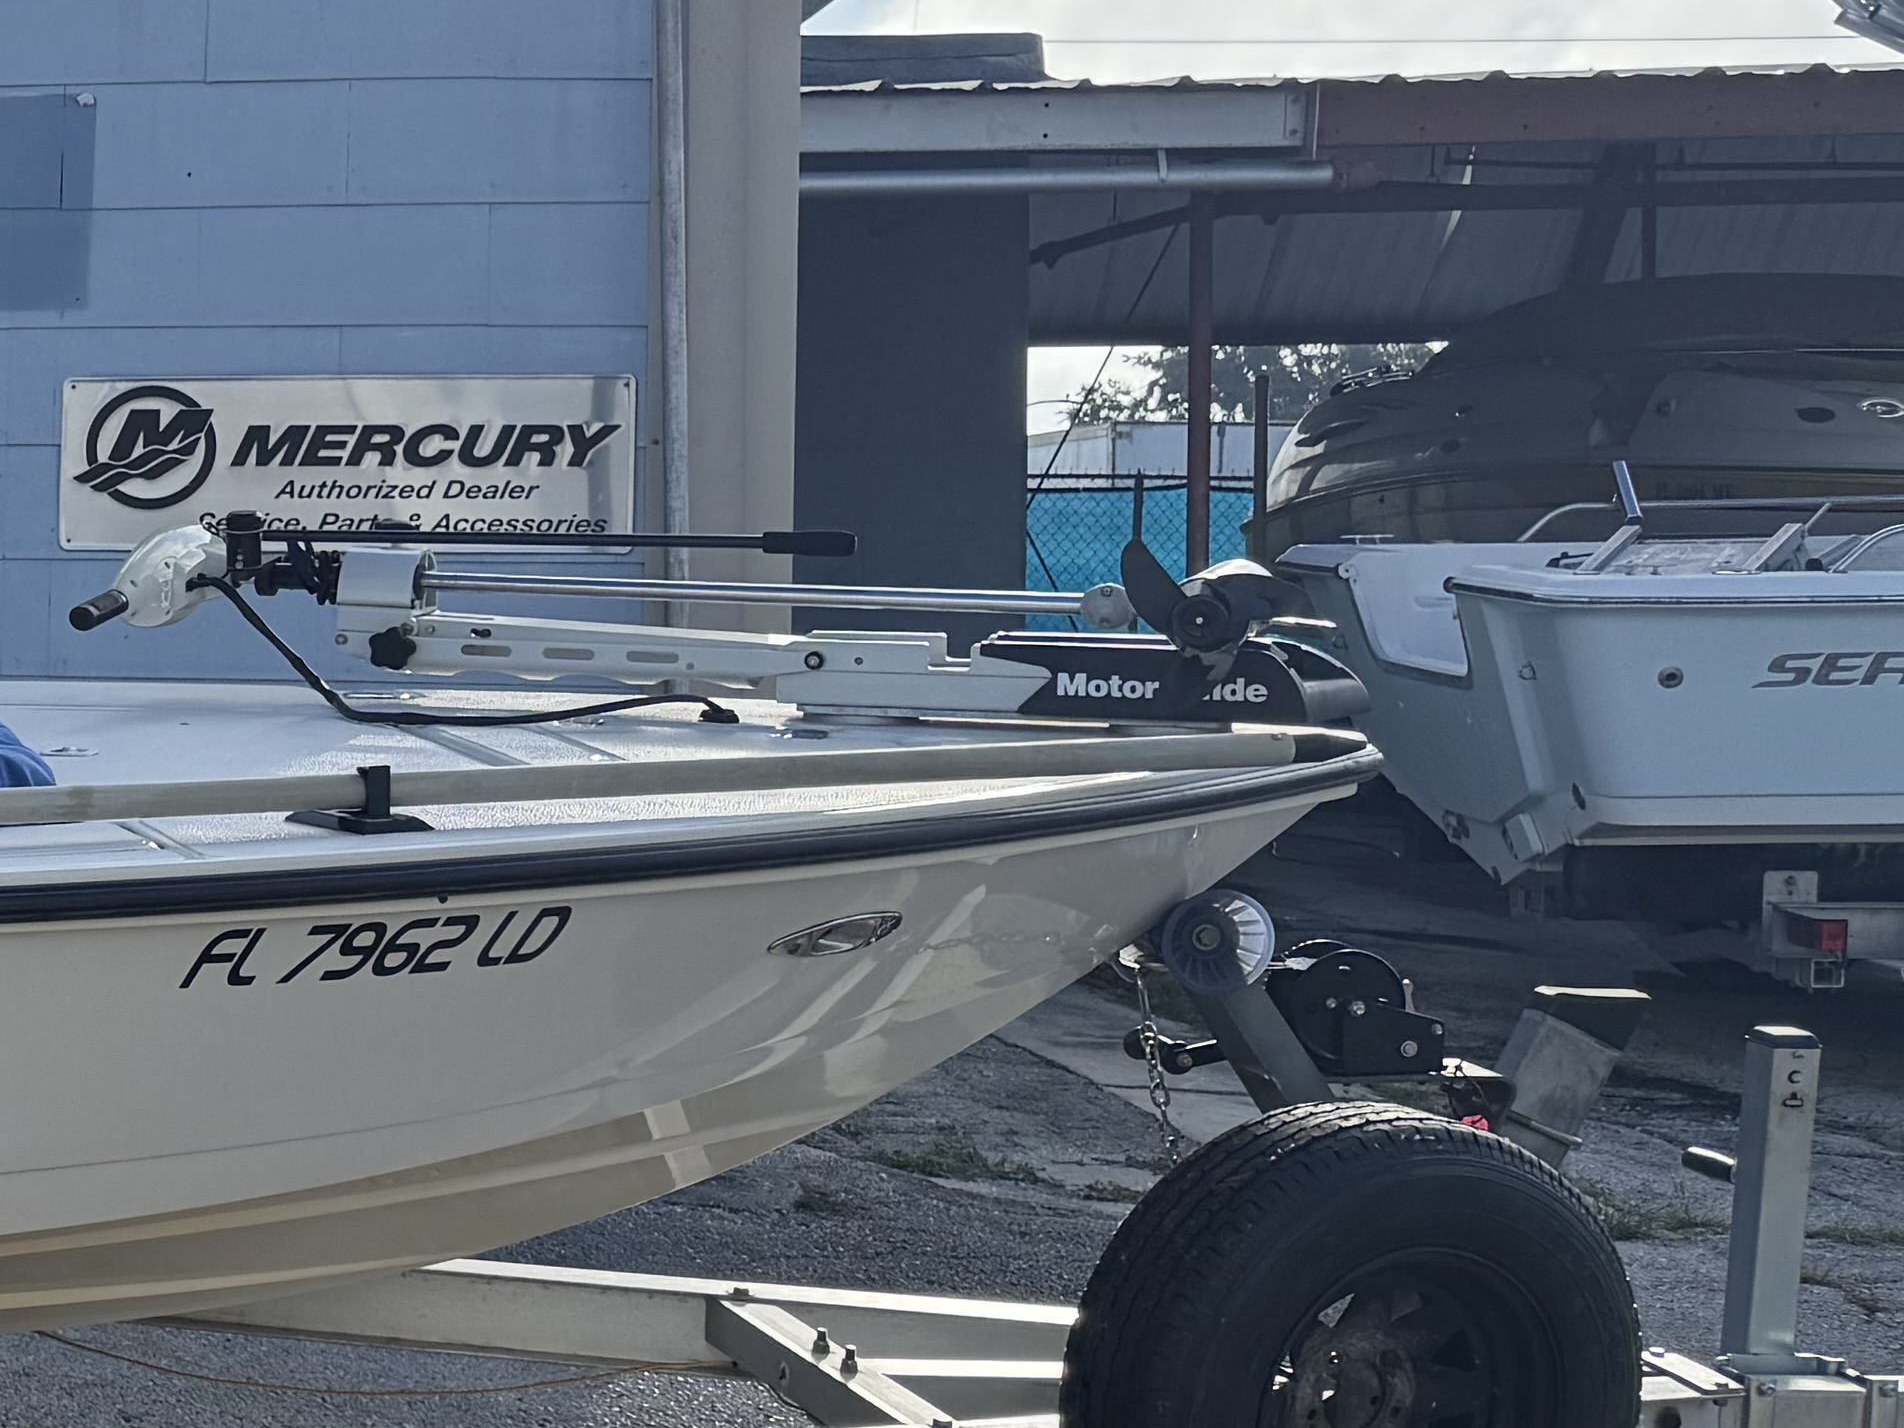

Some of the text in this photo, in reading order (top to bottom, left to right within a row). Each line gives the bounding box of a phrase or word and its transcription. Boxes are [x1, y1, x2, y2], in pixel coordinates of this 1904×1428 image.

[230, 423, 622, 468] MERCURY
[274, 479, 540, 500] Authorized Dealer
[318, 513, 380, 531] Part
[431, 513, 607, 533] Accessories
[179, 905, 573, 989] FL 7962 LD
